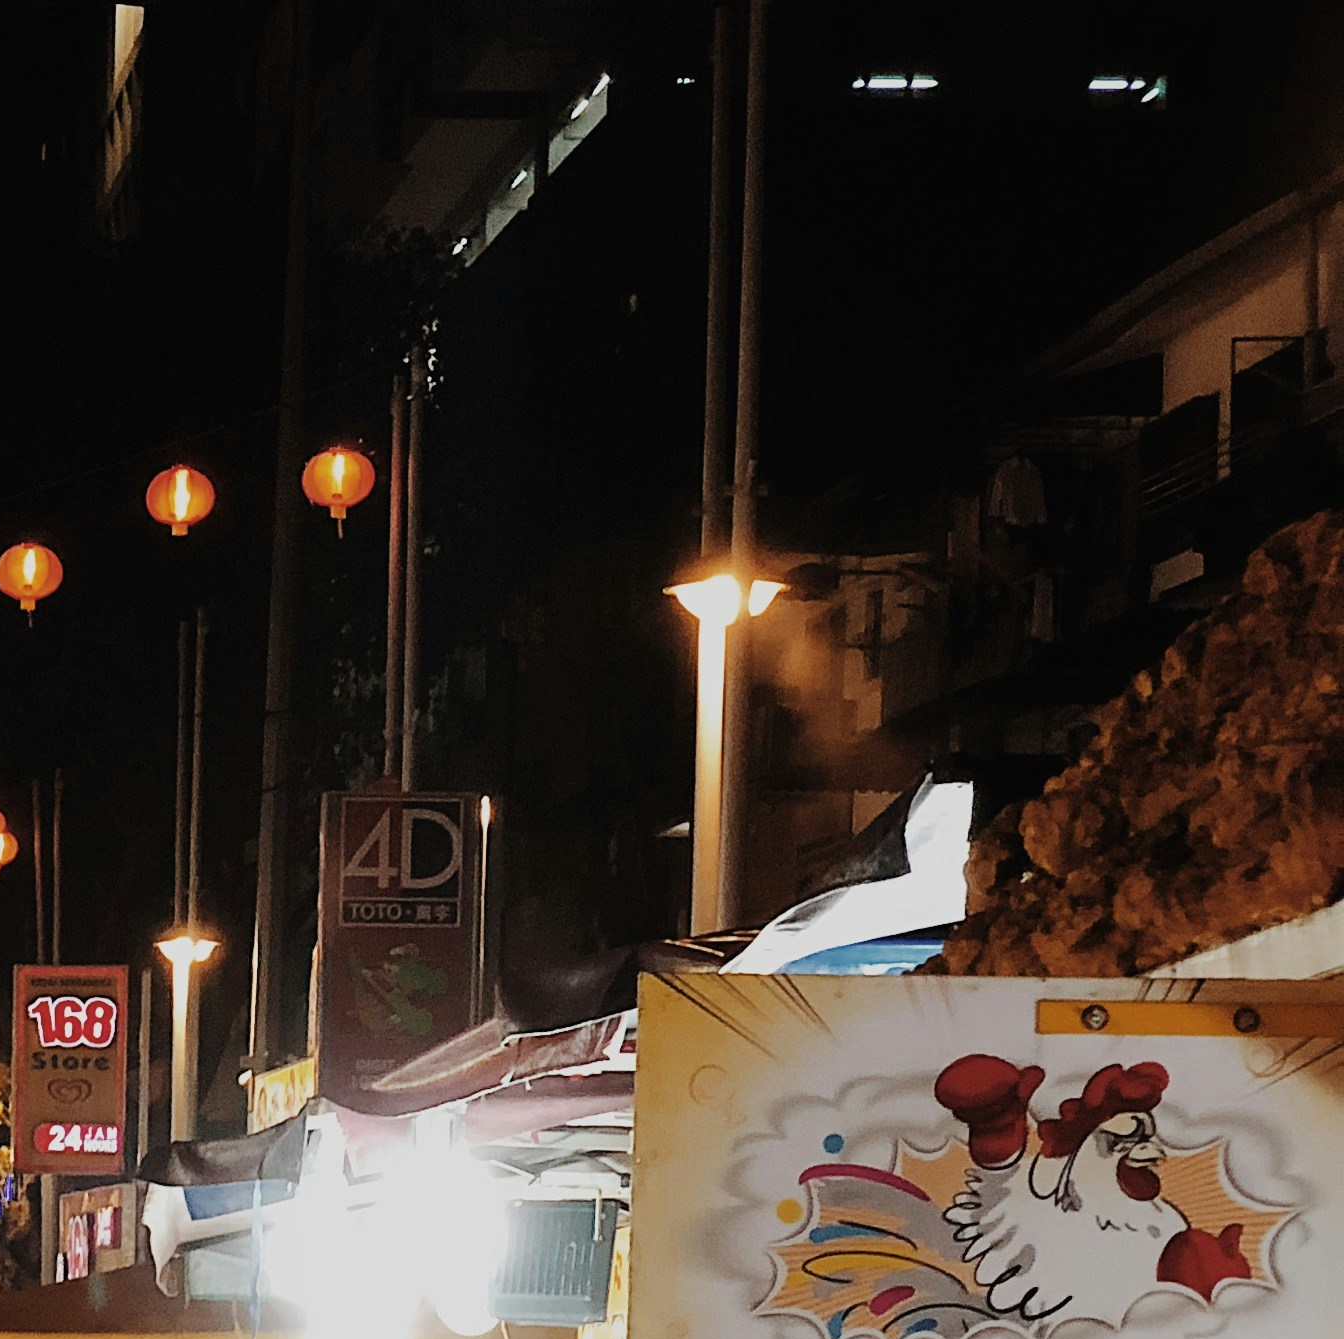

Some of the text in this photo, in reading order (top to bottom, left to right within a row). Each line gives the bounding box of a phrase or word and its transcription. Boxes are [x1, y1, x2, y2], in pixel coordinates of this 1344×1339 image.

[343, 807, 462, 890] 4D
[350, 902, 403, 922] TOTO
[27, 996, 118, 1049] 168
[31, 1051, 111, 1071] Store
[48, 1125, 83, 1152] 24
